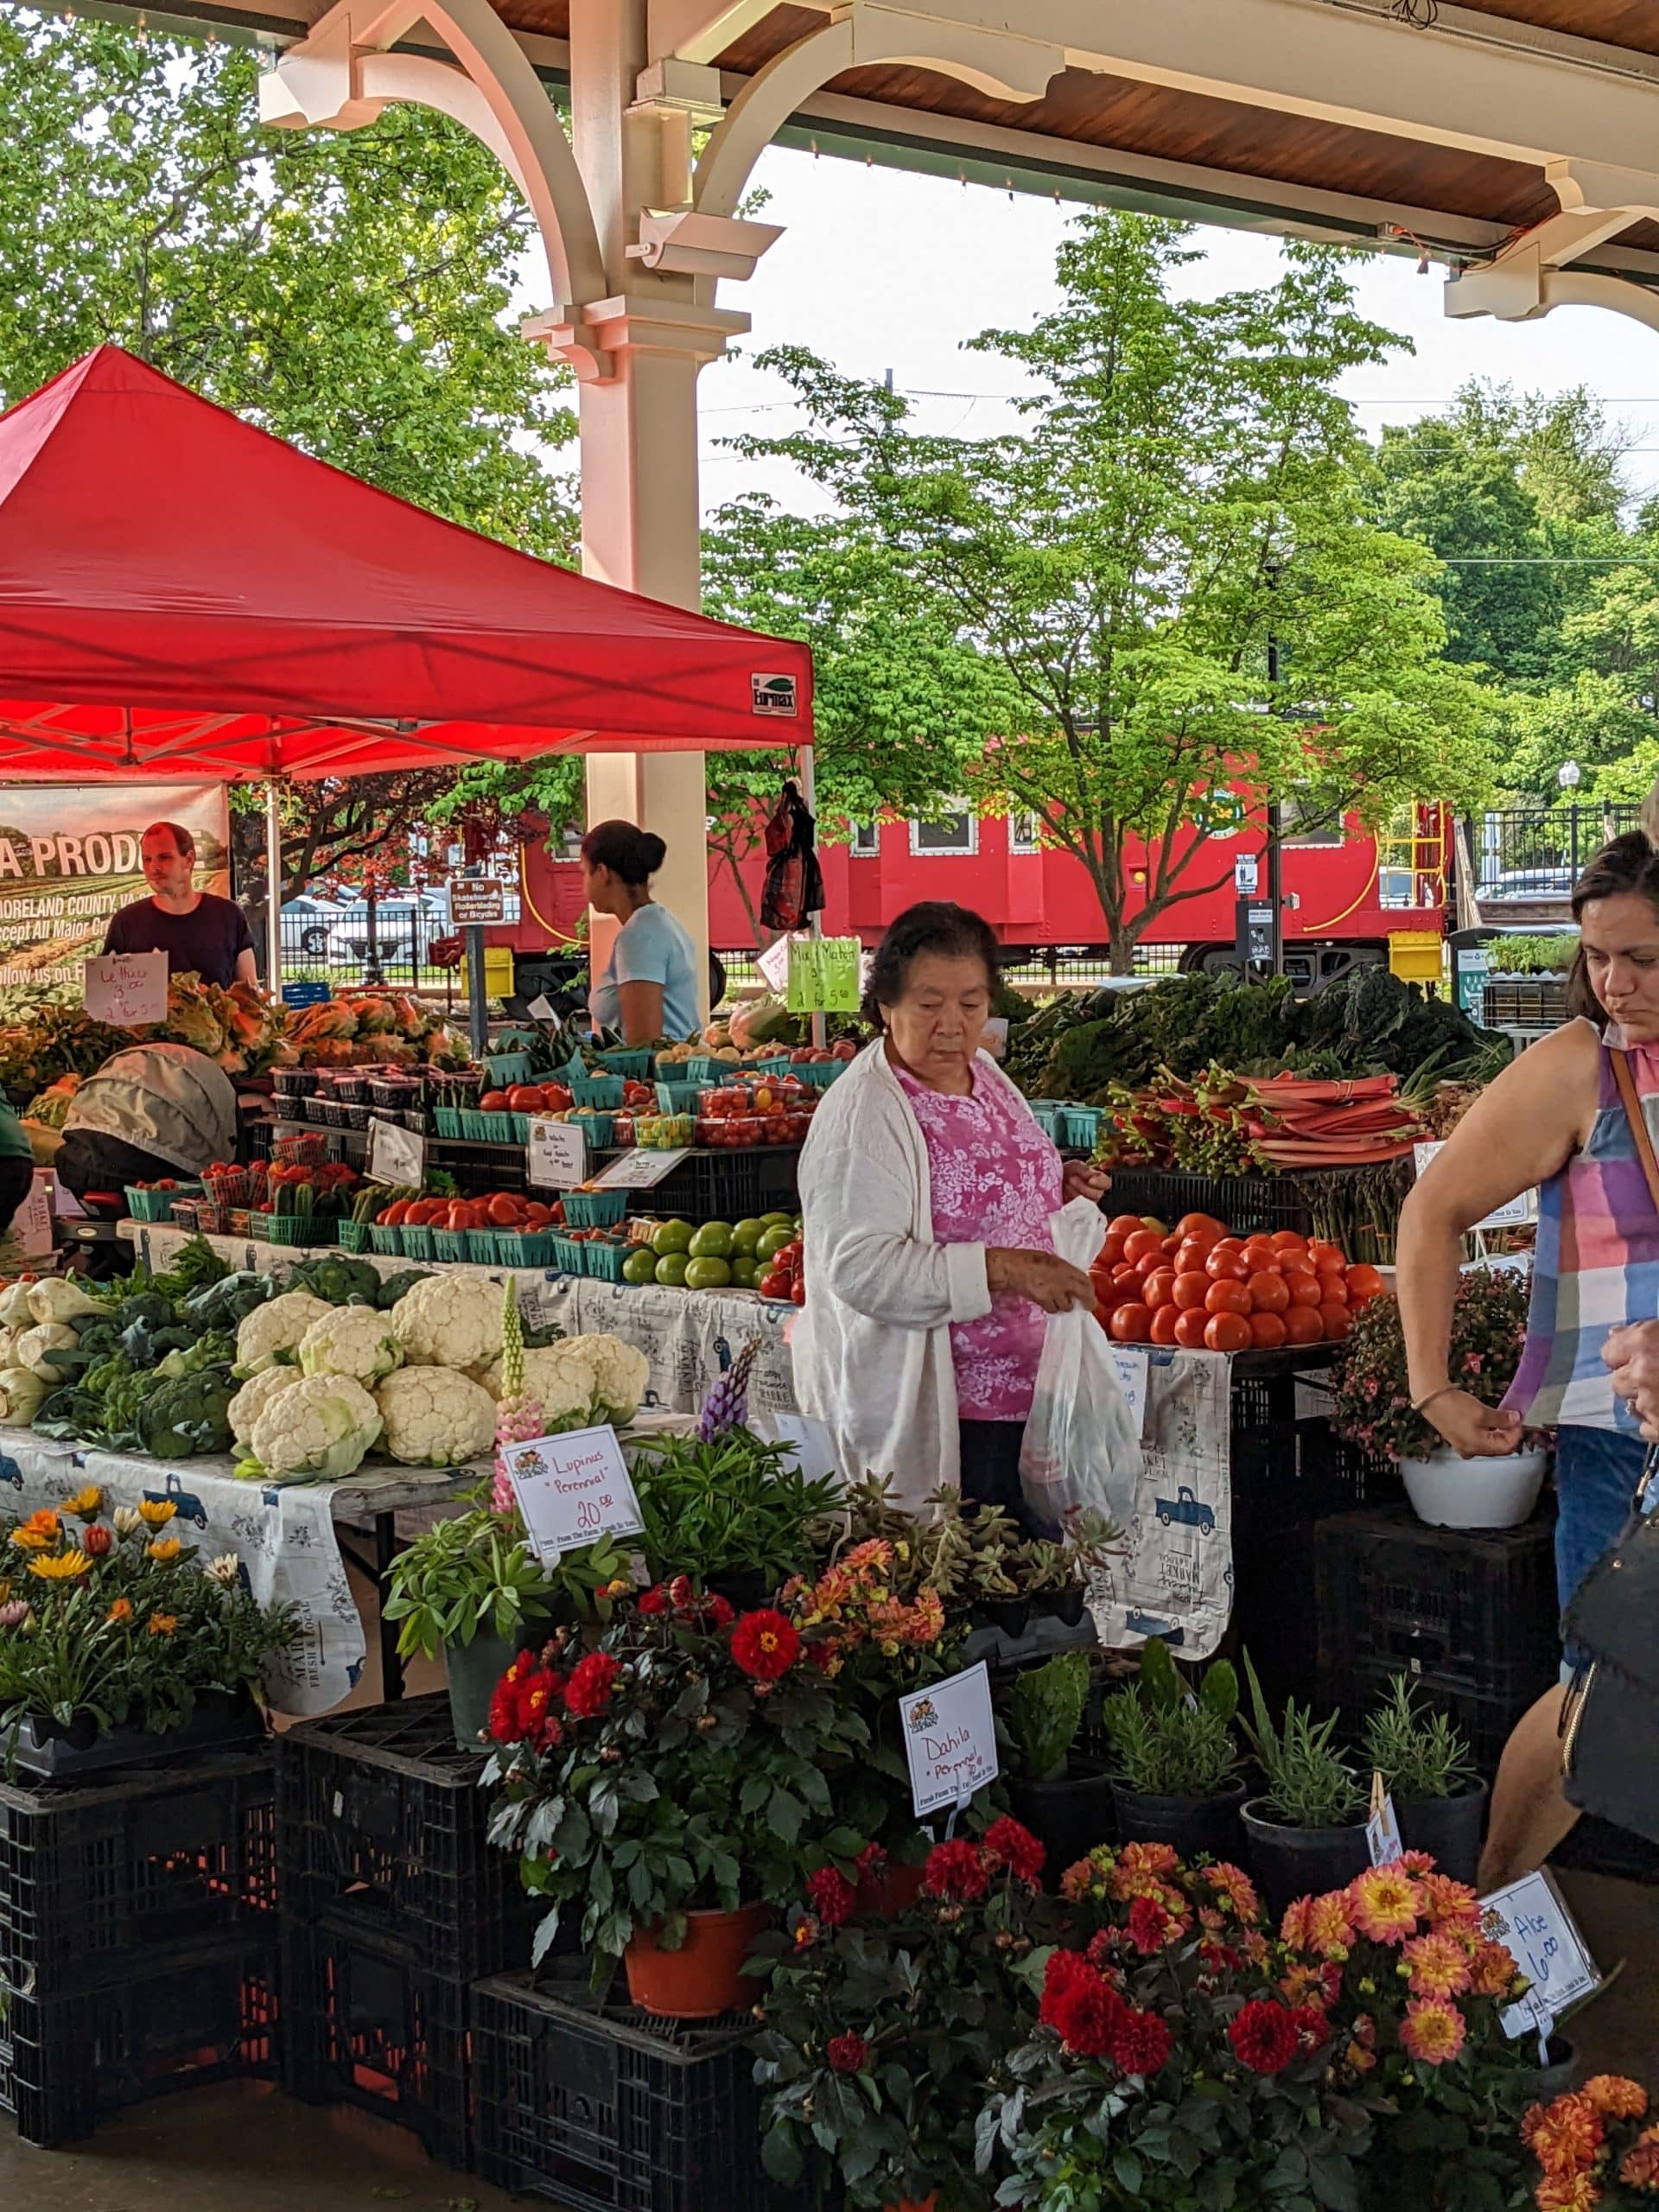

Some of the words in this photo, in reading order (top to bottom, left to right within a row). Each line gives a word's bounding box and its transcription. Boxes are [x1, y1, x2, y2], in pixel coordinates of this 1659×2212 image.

[31, 830, 206, 877] PRODE
[472, 882, 485, 892] No
[0, 896, 64, 919] ORELAND
[469, 910, 498, 919] Bicycles
[33, 919, 49, 939] All
[53, 918, 88, 941] Major
[35, 968, 52, 984] us
[55, 966, 73, 983] on
[552, 1451, 604, 1475] Lupinus
[306, 1652, 320, 1688] FRESH
